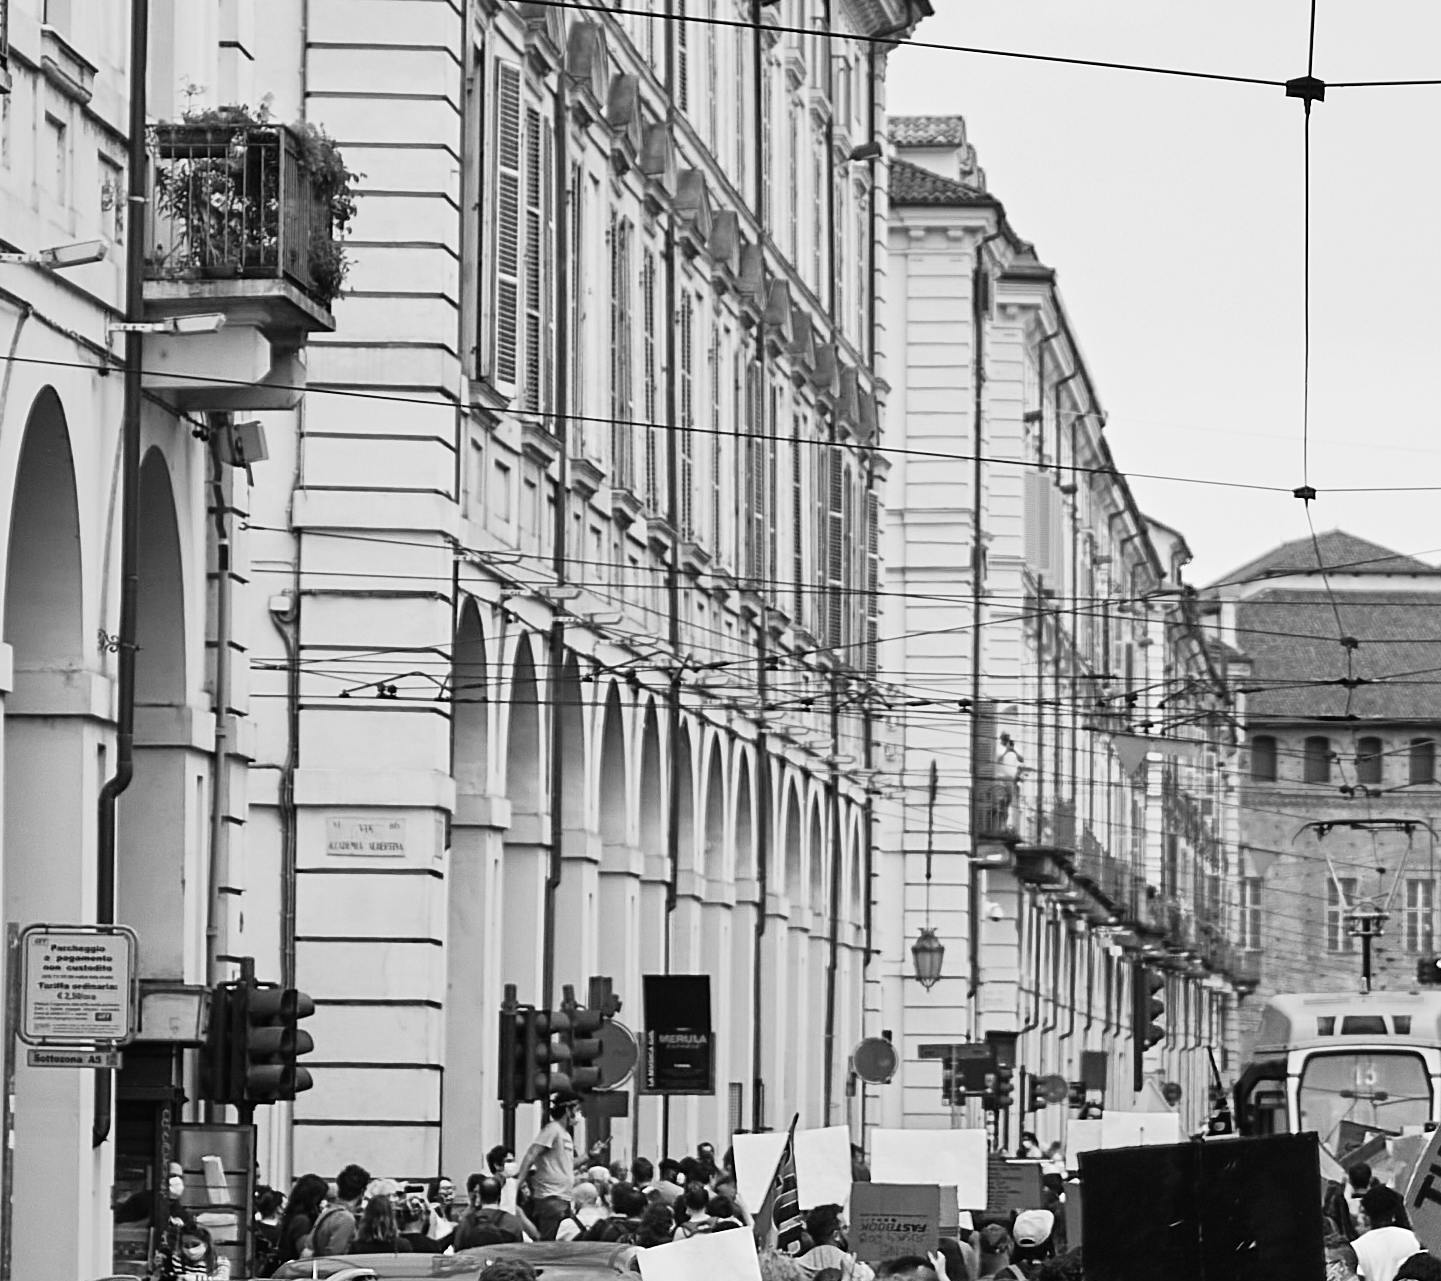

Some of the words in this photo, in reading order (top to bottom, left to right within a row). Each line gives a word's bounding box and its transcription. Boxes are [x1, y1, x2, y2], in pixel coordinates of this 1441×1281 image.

[50, 944, 106, 953] Parcheggio
[56, 954, 113, 963] pagamento
[65, 964, 113, 972] custodito
[658, 1033, 708, 1044] MERULA
[33, 1053, 84, 1064] Sottozona
